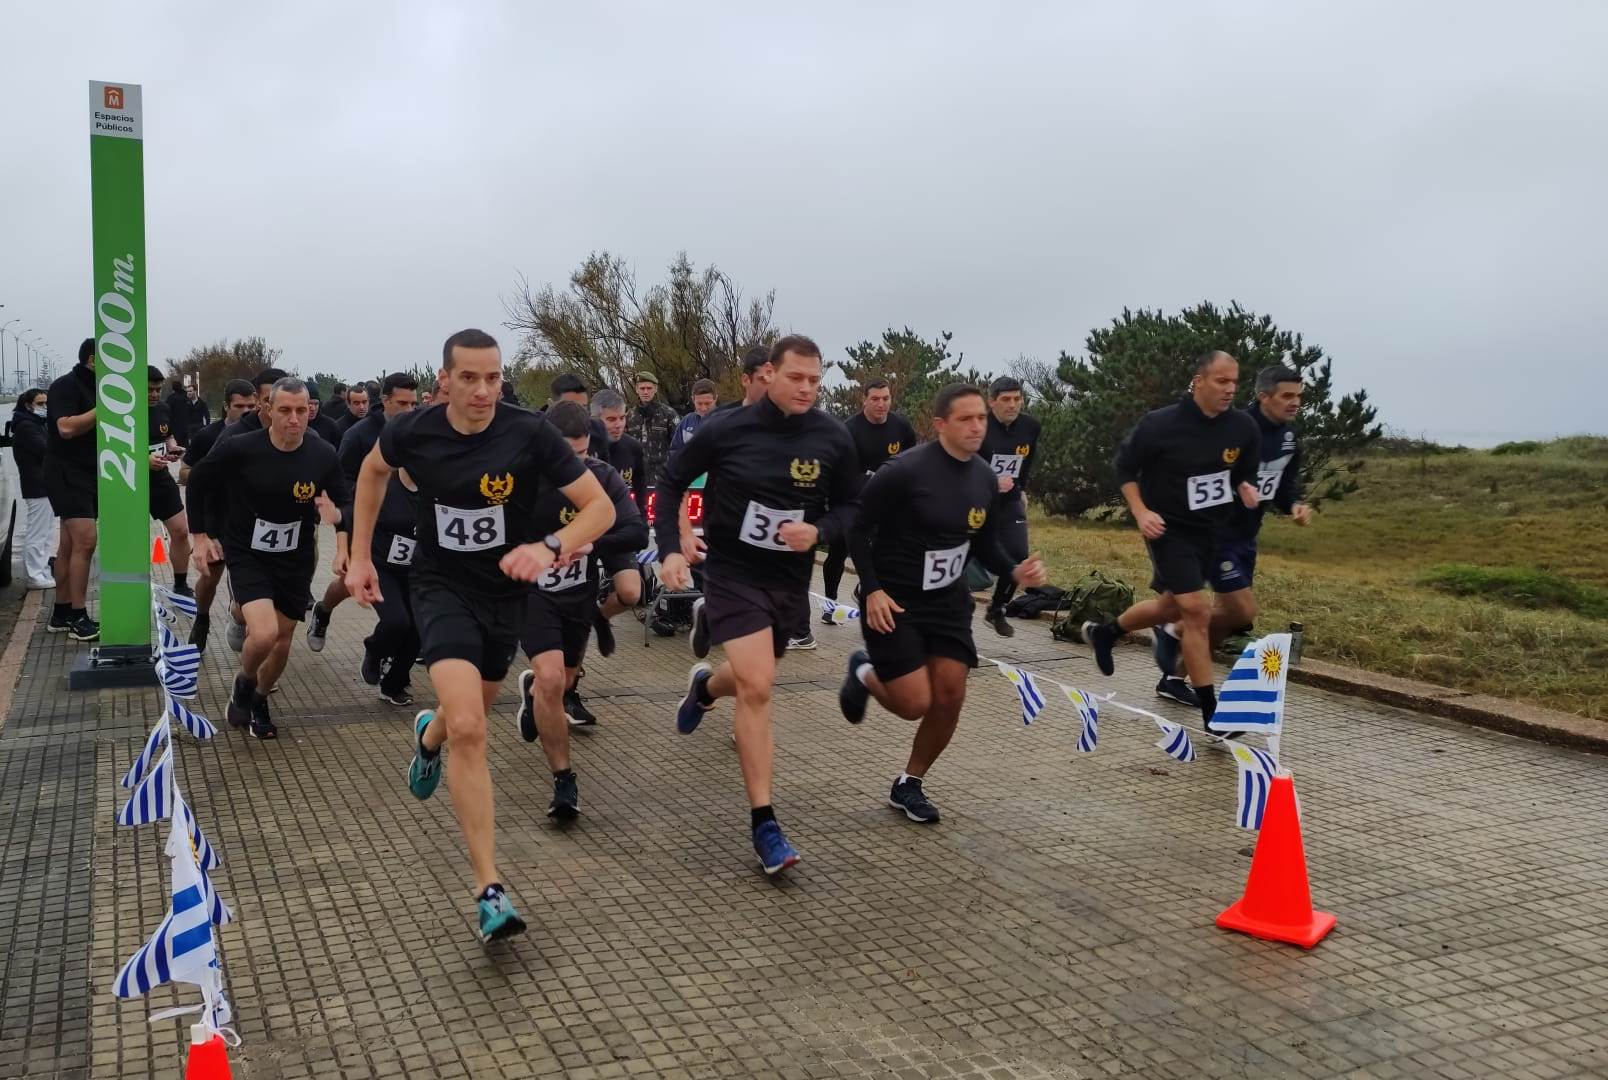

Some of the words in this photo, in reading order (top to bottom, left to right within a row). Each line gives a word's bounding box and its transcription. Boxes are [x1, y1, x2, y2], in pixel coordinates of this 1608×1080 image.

[94, 111, 135, 123] Espacios
[95, 121, 134, 133] Públicos
[994, 459, 1018, 475] 54
[1194, 478, 1225, 504] 53
[259, 527, 295, 549] 41
[444, 516, 498, 546] 48
[544, 559, 582, 589] 34
[929, 553, 963, 584] 50
